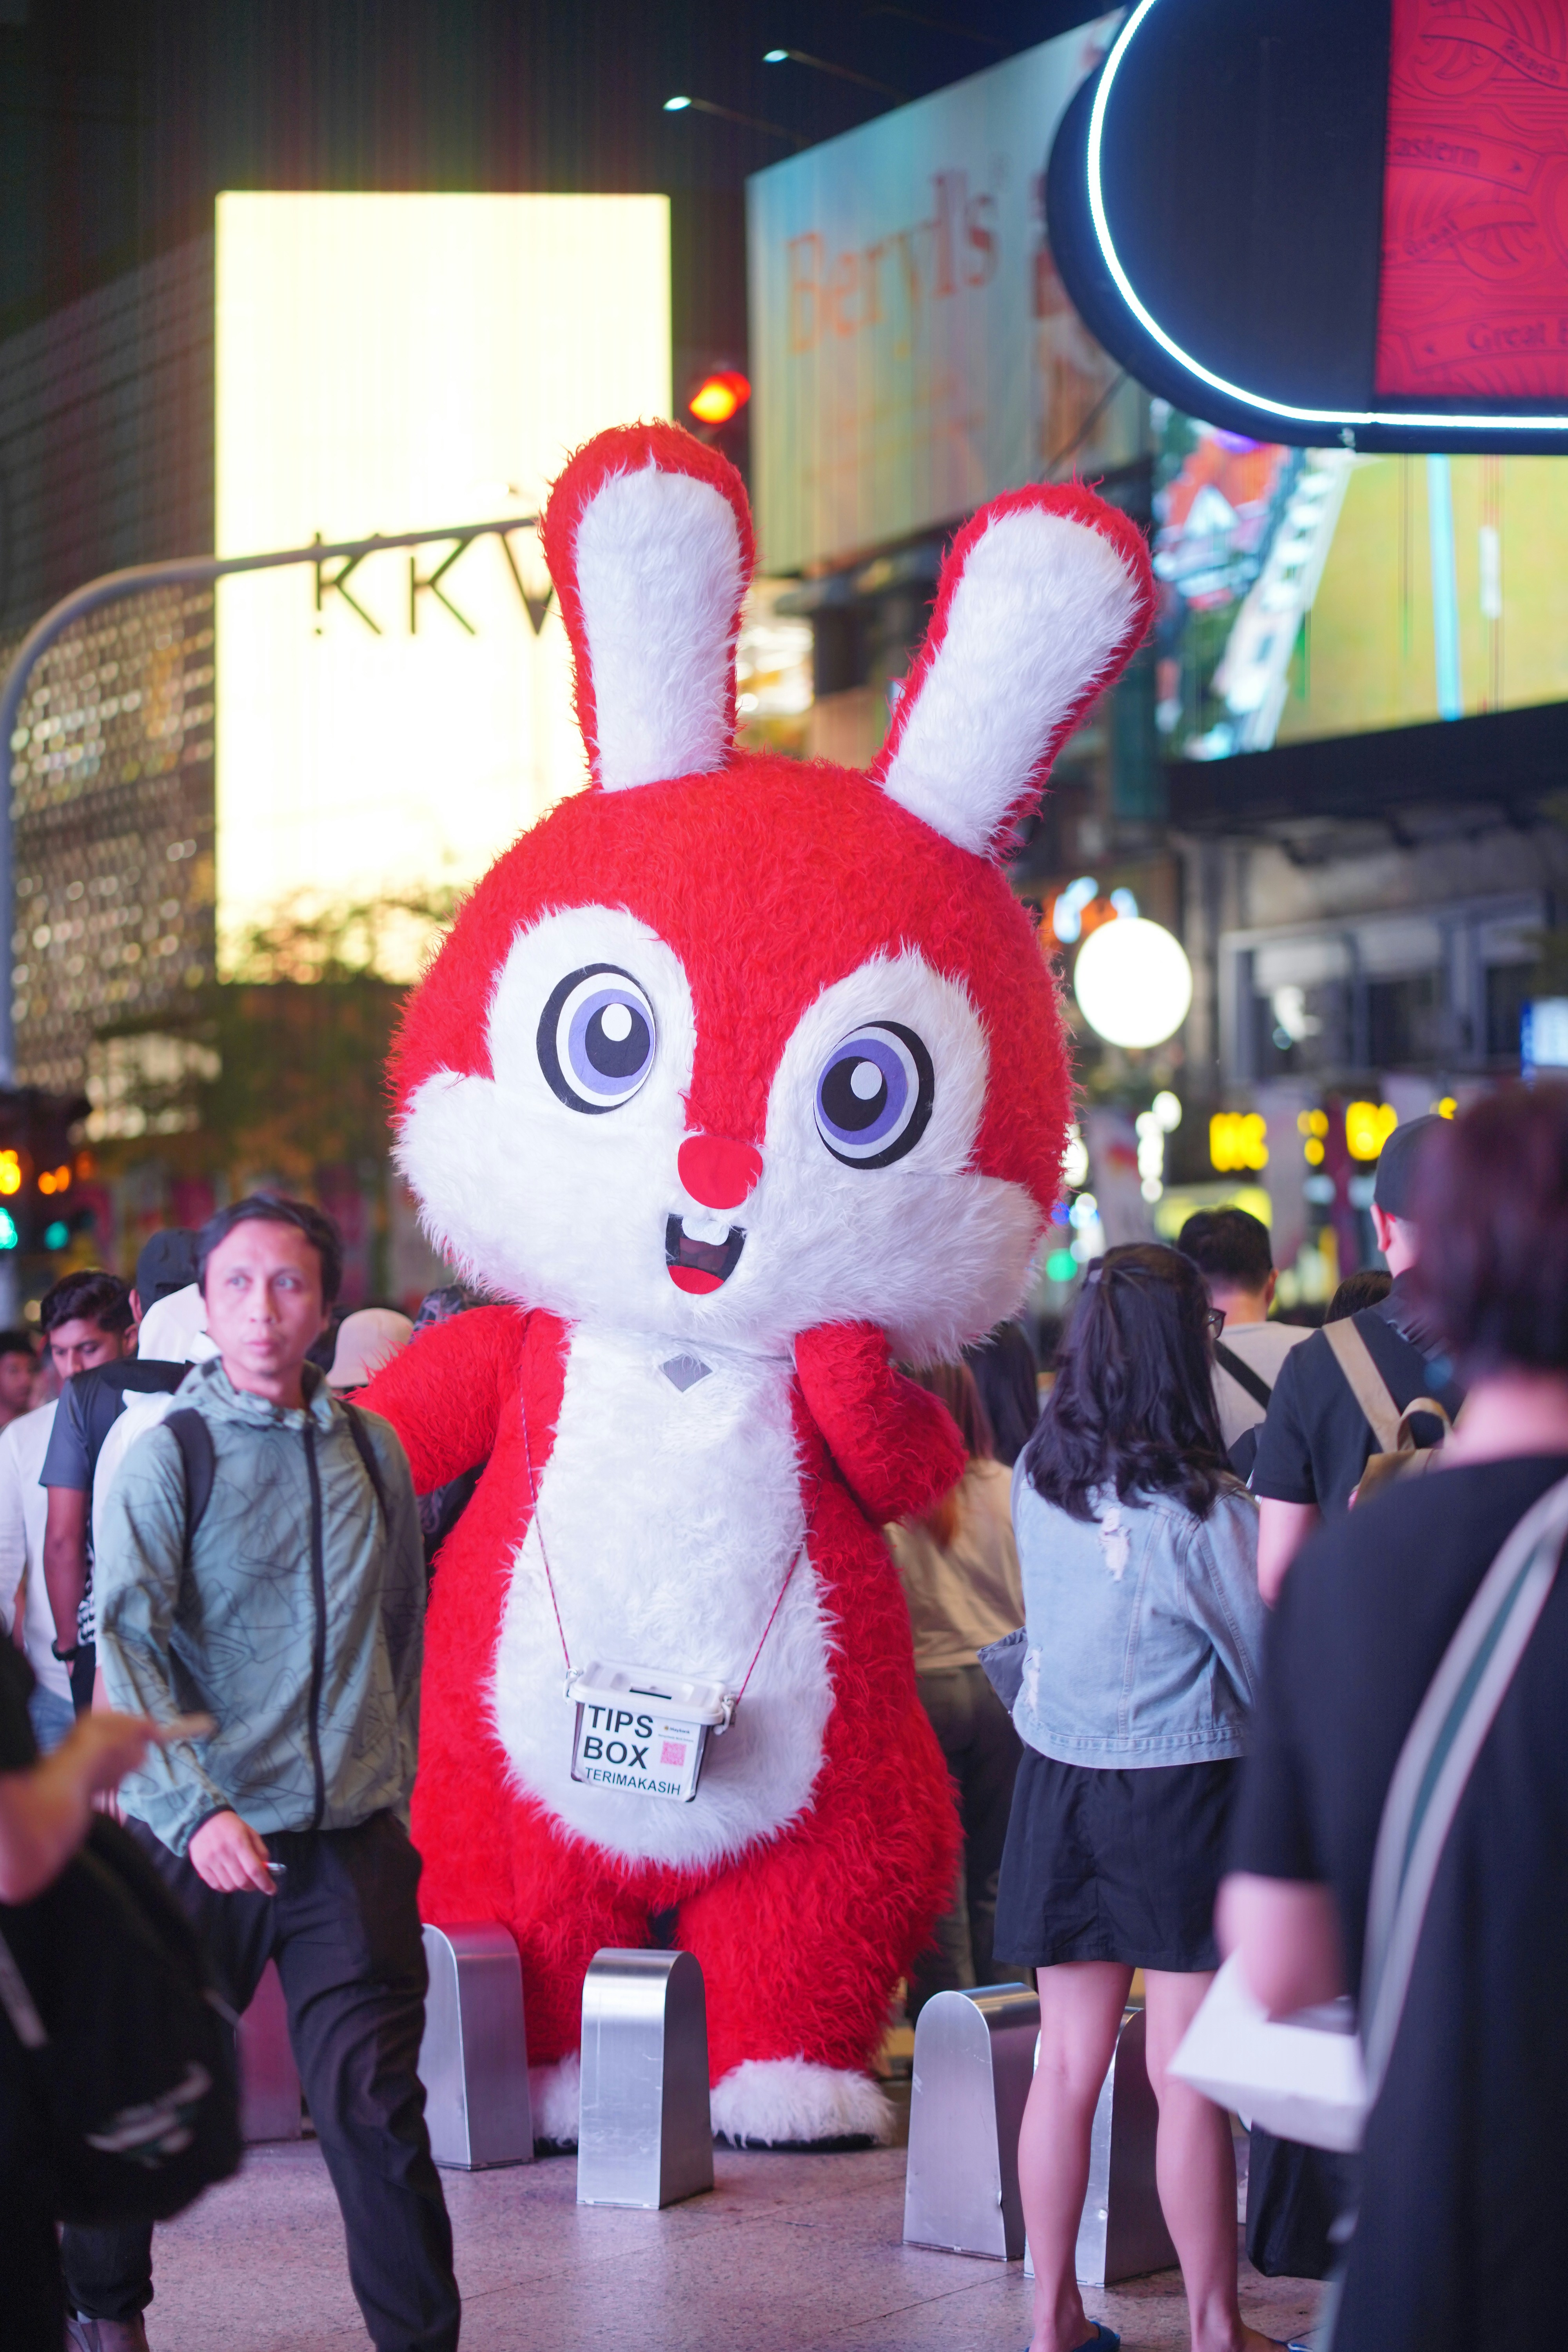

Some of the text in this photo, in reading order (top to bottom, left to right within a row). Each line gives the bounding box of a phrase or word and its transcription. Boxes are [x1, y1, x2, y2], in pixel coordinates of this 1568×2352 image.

[1466, 321, 1545, 353] Great
[589, 1705, 653, 1738] TIPS
[584, 1736, 649, 1769] BOX
[585, 1767, 681, 1795] TERIMAKASIH
